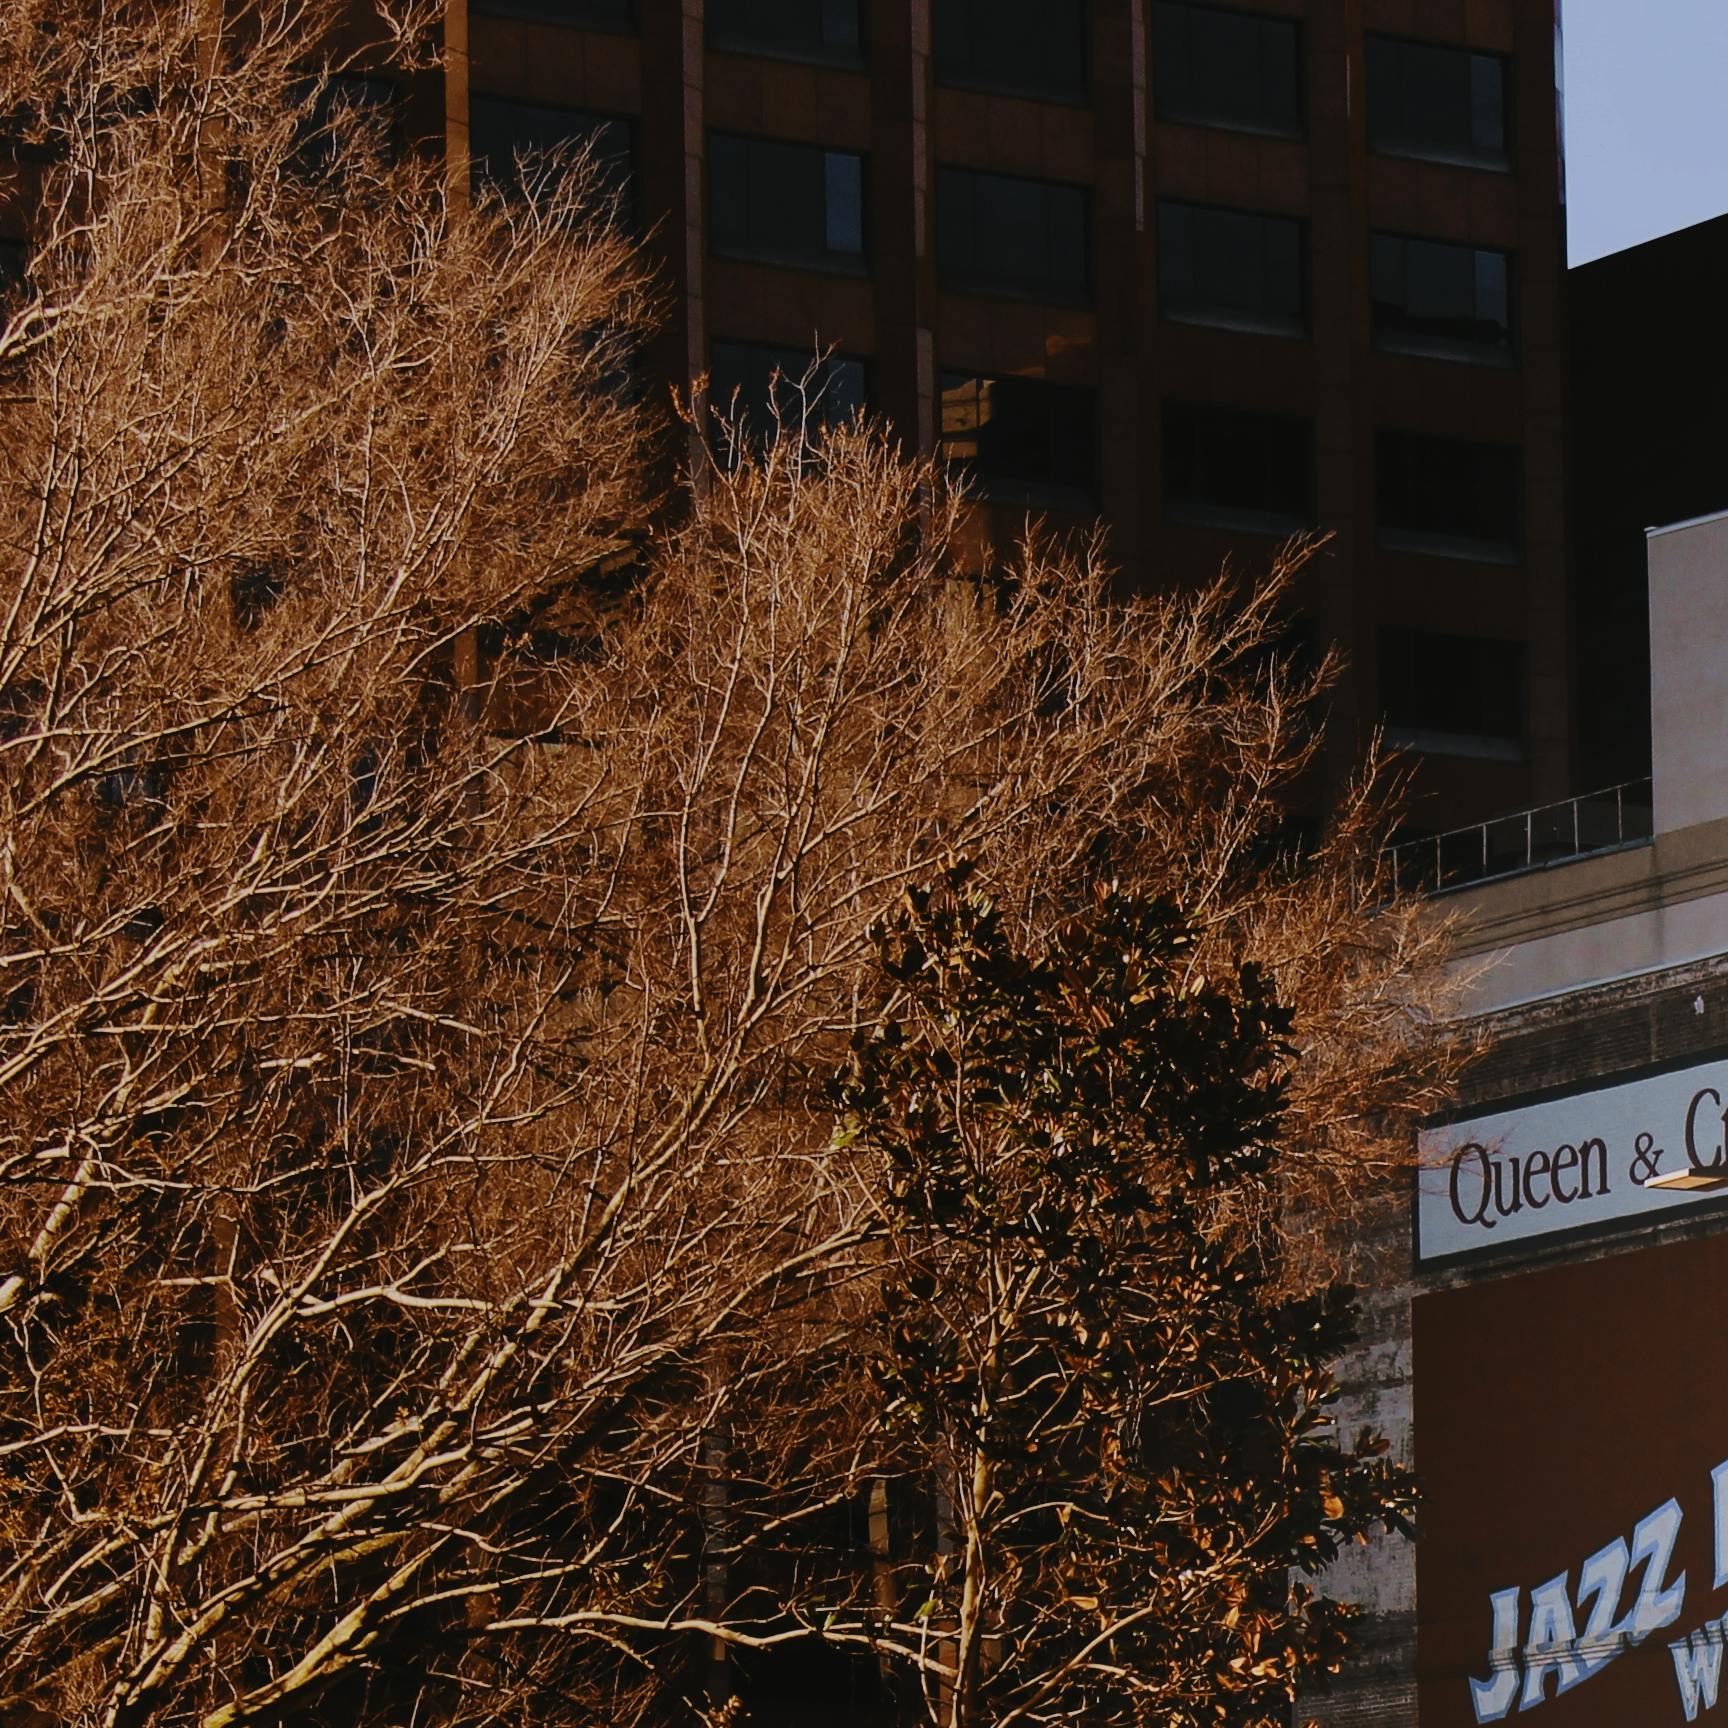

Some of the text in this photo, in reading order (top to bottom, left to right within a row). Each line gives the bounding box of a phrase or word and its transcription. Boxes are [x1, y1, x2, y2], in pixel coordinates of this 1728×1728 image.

[1449, 1137, 1611, 1229] Queen
[1629, 1132, 1664, 1185] &
[1468, 1497, 1686, 1724] JAZZ
